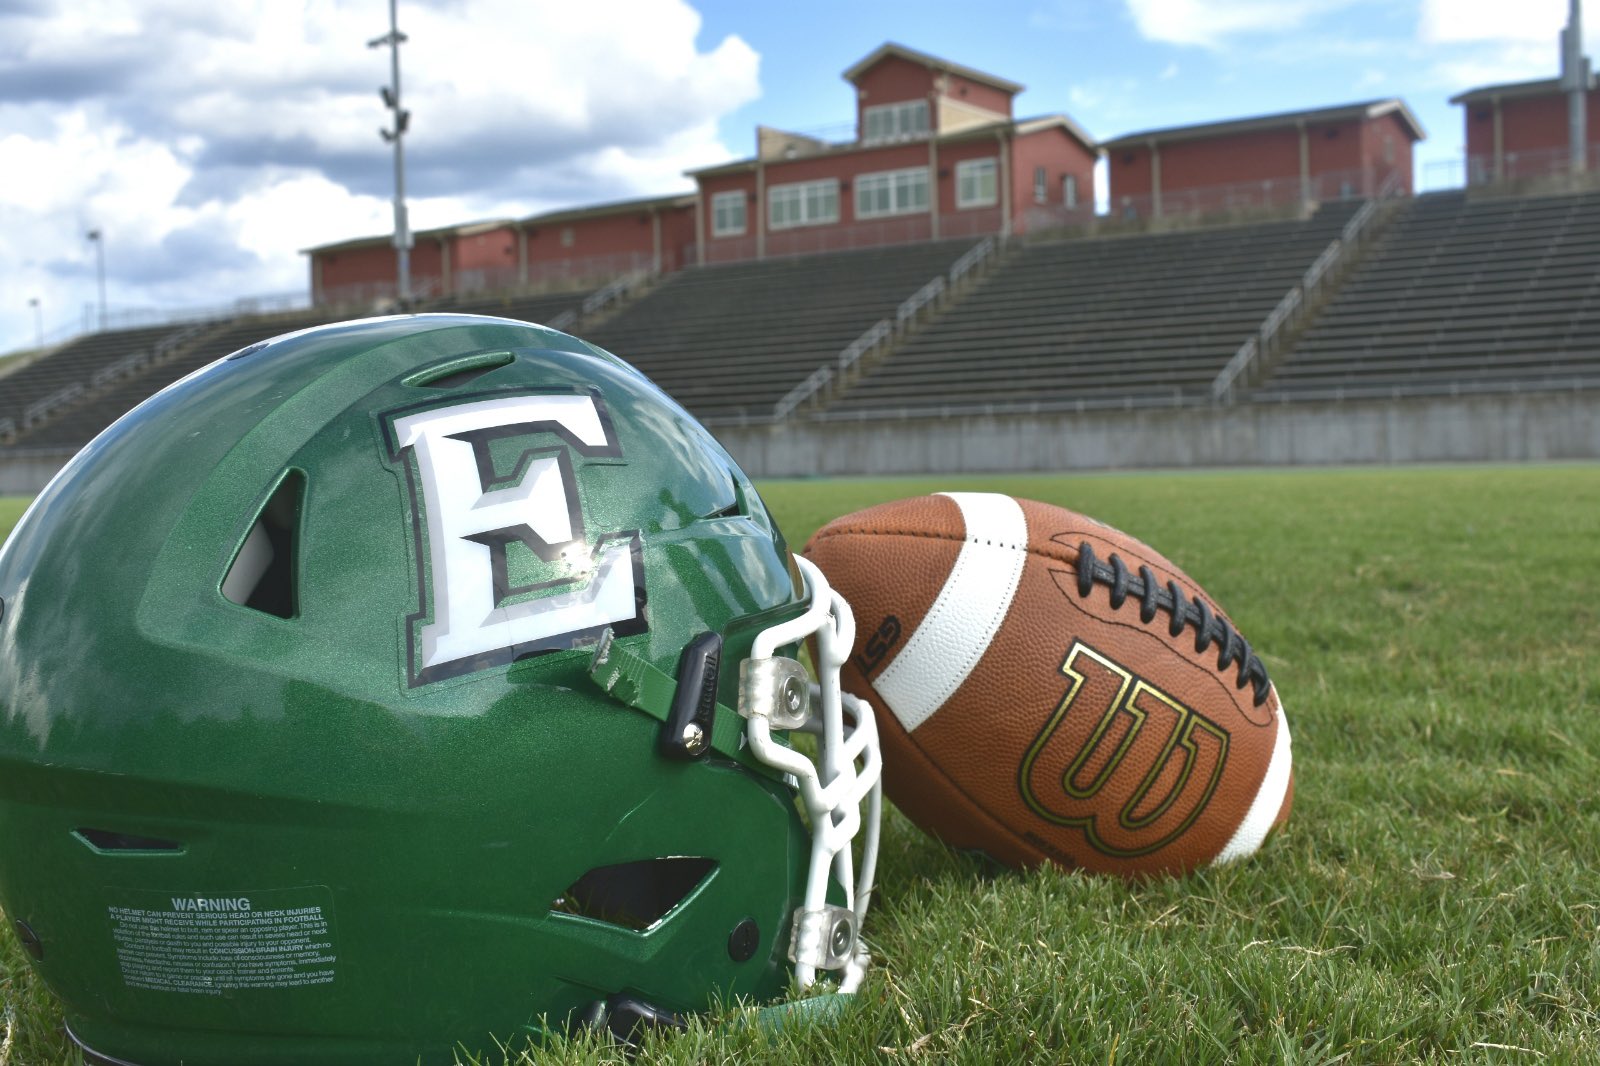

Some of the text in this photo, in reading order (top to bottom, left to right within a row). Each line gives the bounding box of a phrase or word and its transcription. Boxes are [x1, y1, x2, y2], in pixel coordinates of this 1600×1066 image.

[378, 386, 648, 688] E
[856, 615, 901, 678] GST
[1017, 635, 1231, 859] W
[171, 897, 251, 911] WARNING
[119, 908, 145, 916] HELMET
[162, 911, 194, 919] PREVENT
[286, 906, 321, 916] INJURIES
[116, 914, 140, 923] PLAYER
[163, 918, 194, 926] RECEIVE
[218, 918, 273, 926] PARTICIPATING
[283, 914, 324, 923] FOOTBALL
[250, 926, 278, 934] opposing
